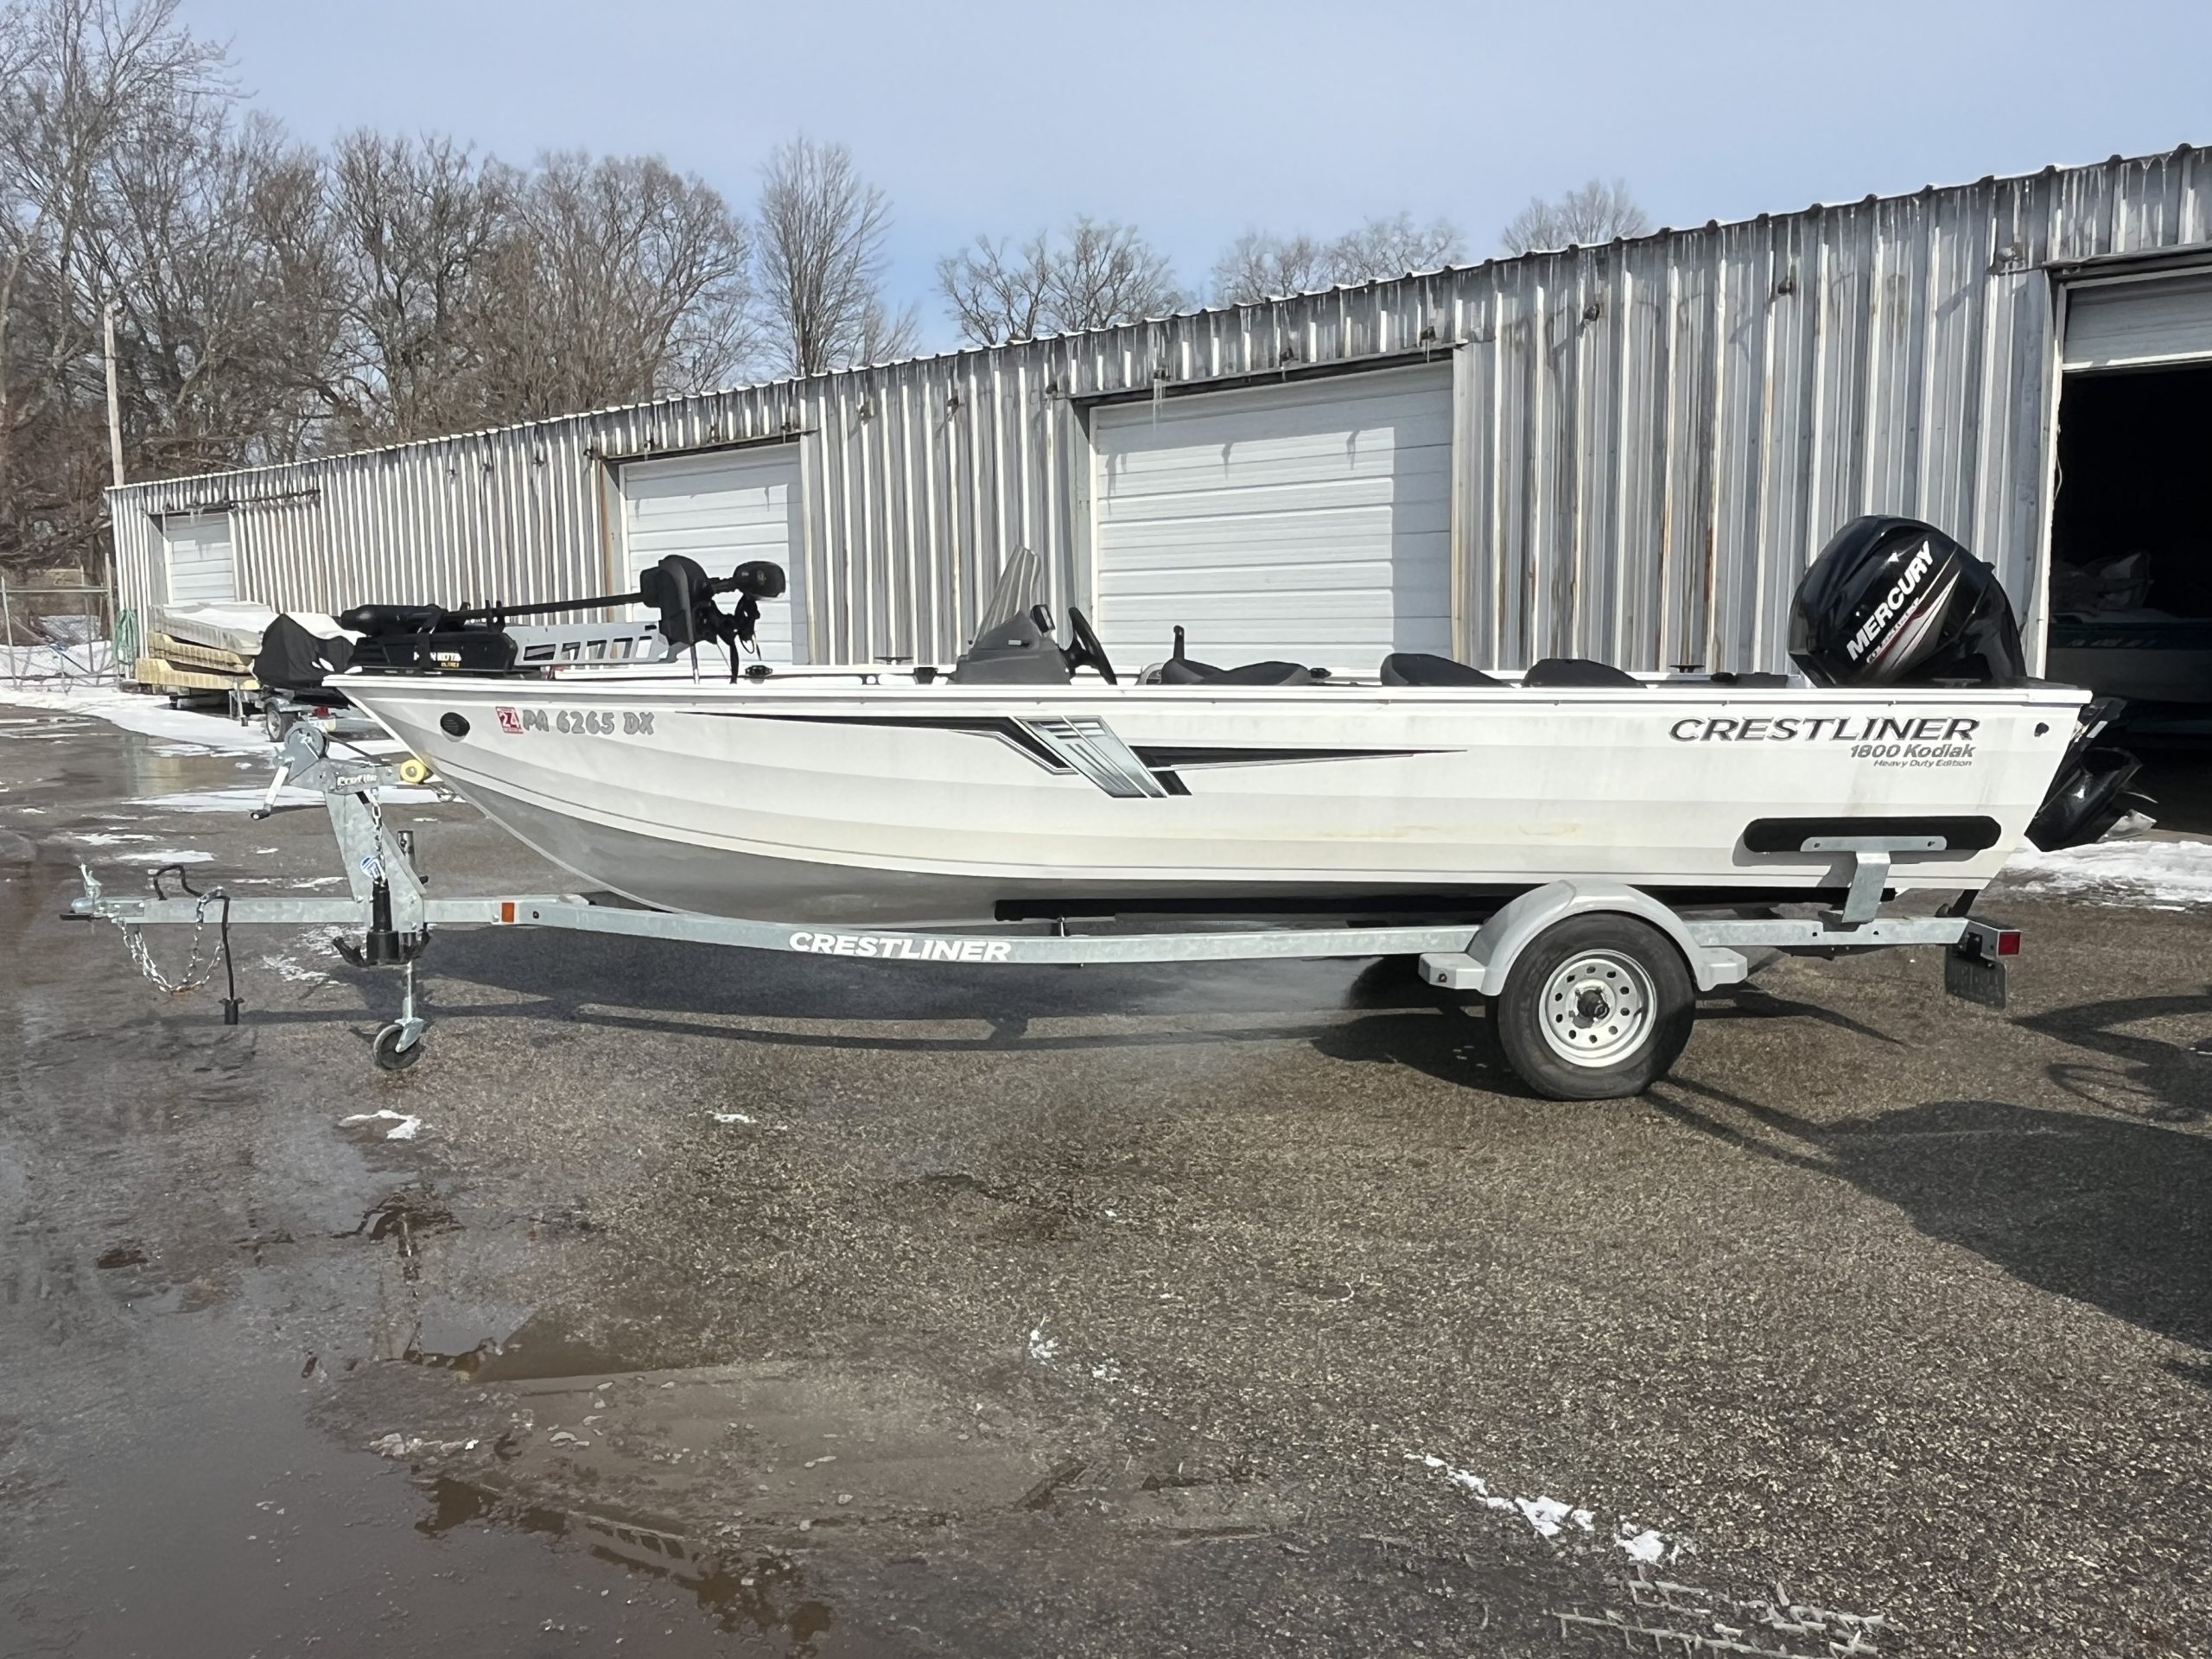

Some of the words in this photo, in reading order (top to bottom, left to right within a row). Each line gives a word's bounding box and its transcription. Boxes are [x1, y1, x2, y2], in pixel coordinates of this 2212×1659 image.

[1847, 540, 1933, 661] MERCURY
[499, 709, 519, 728] 24
[523, 709, 549, 732] PA
[556, 710, 614, 734] 6265
[623, 712, 654, 735] DX
[1669, 717, 1980, 741] CRESTLINER
[1851, 744, 1901, 758] 1800
[1903, 744, 1976, 758] Kodiak
[1873, 760, 1908, 768] Heavy
[1909, 760, 1935, 768] Duty
[789, 931, 1011, 962] CRESTLINER
